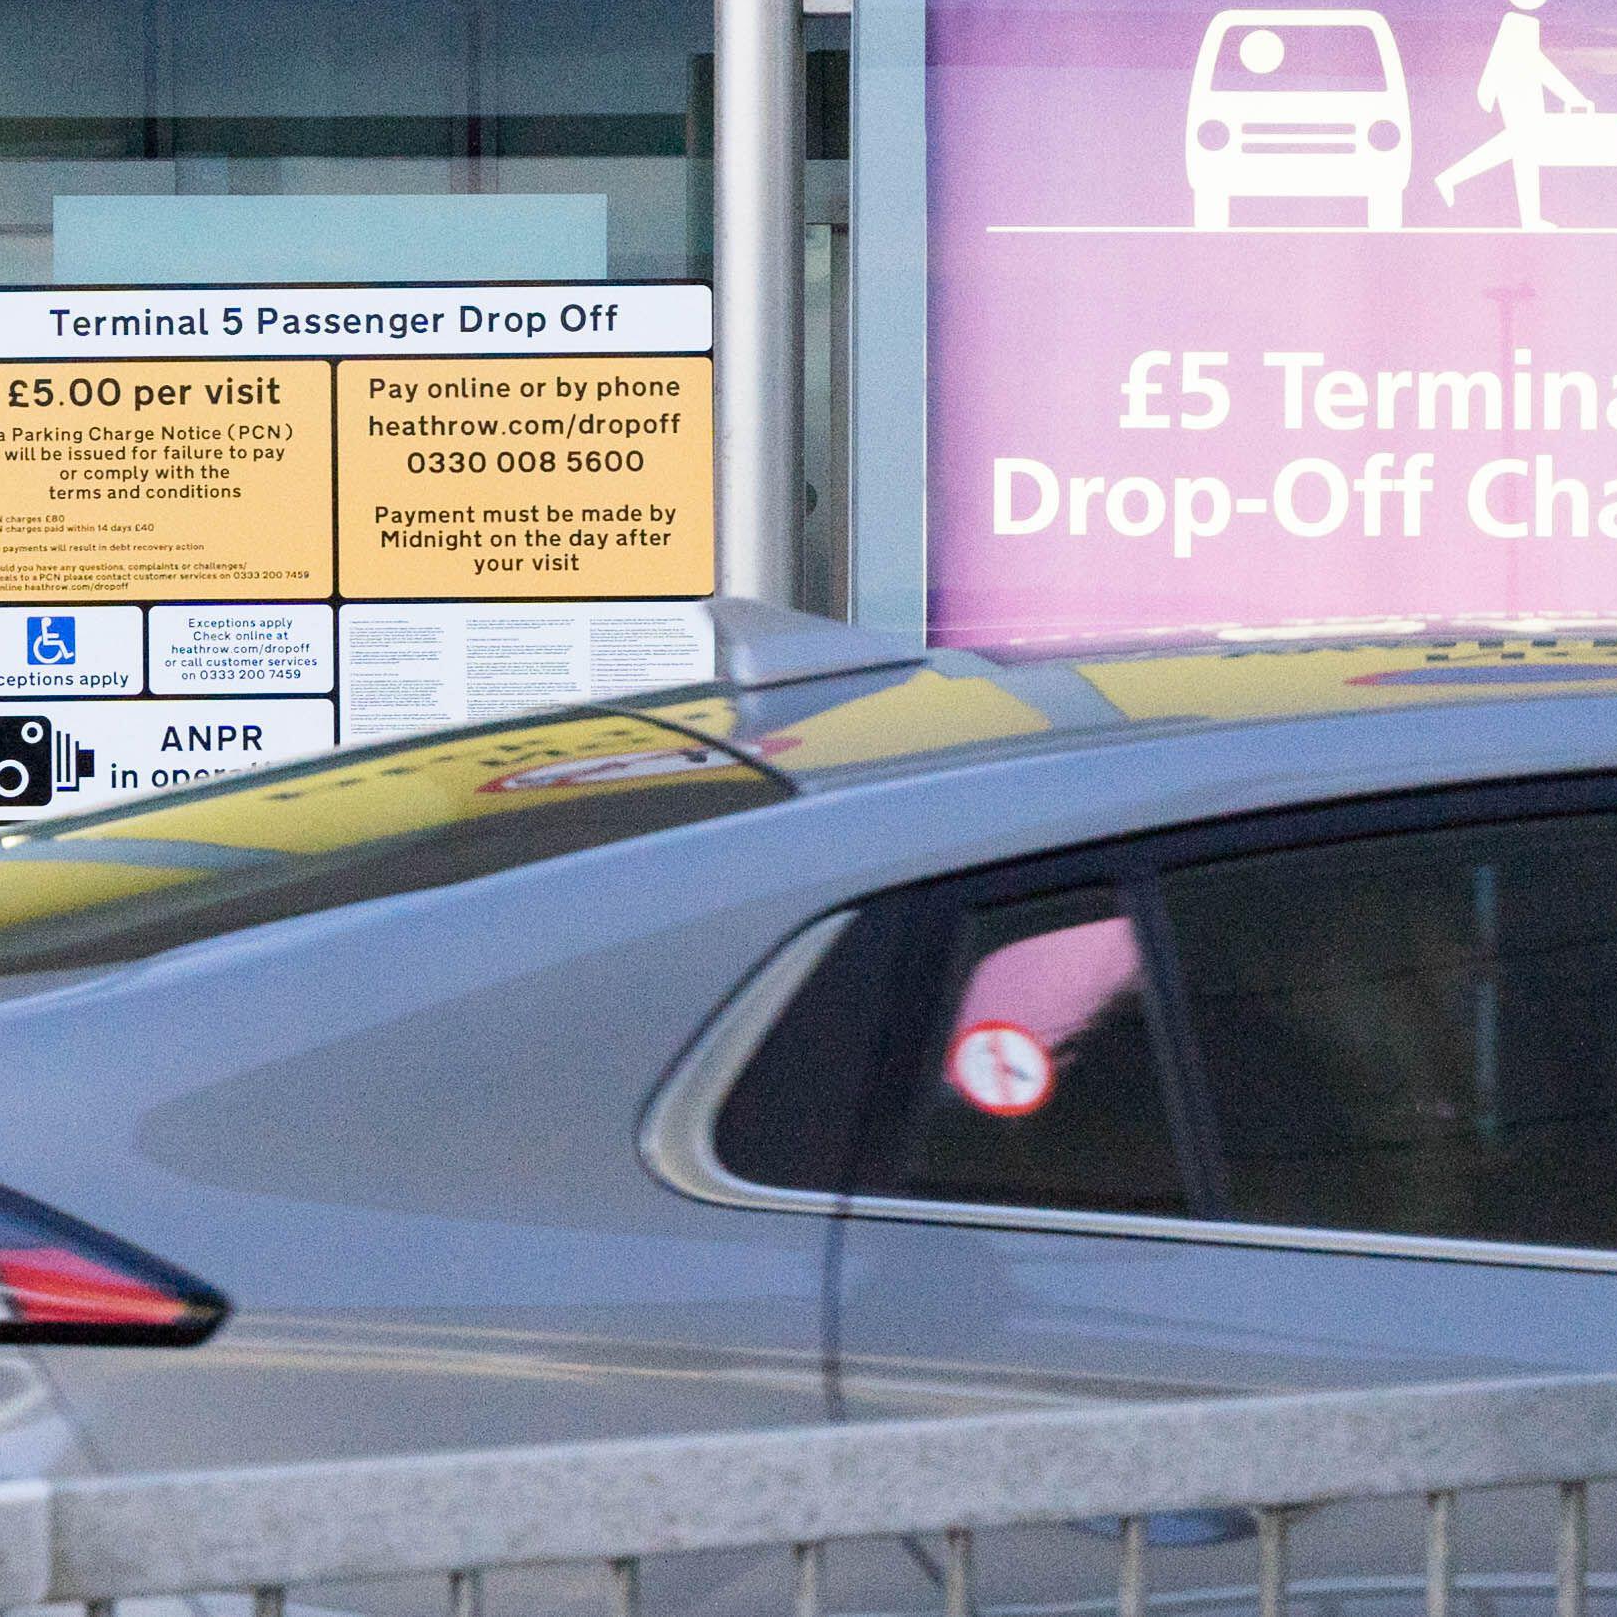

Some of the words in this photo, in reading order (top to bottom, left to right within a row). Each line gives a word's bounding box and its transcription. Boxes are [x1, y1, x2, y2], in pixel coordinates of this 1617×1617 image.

[49, 307, 208, 336] Terminal
[223, 307, 242, 335] 5
[258, 306, 444, 340] Passenger
[460, 305, 545, 338] Drop
[560, 303, 617, 332] Off
[8, 377, 120, 407] £5.00
[135, 384, 191, 411] per
[205, 377, 279, 404] visit
[369, 377, 417, 403] Pay
[427, 377, 510, 398] online
[520, 382, 546, 397] or
[557, 376, 587, 401] by
[597, 375, 679, 401] phone
[1119, 350, 1229, 429] £5
[12, 427, 82, 444] Parking
[89, 426, 153, 443] Charge
[161, 425, 221, 440] Notice
[227, 423, 292, 441] (PCN)
[369, 412, 680, 440] heathrow.com/dropoff
[5, 447, 35, 460] will
[41, 446, 61, 460] be
[68, 446, 125, 460] issued
[131, 445, 157, 460] for
[163, 445, 222, 459] failure
[229, 445, 247, 459] to
[253, 448, 284, 461] pay
[407, 451, 485, 473] 0330
[497, 451, 555, 472] 008
[567, 450, 643, 472] 5600
[59, 469, 77, 480] or
[83, 465, 148, 482] comply
[155, 465, 193, 479] with
[200, 464, 229, 478] the
[49, 485, 101, 499] terms
[107, 484, 139, 499] and
[145, 484, 241, 498] conditions
[375, 505, 474, 527] Payment
[483, 505, 539, 522] must
[547, 504, 573, 522] be
[582, 504, 641, 522] made
[650, 503, 675, 525] by
[994, 452, 1434, 557] Drop-Off
[5, 515, 41, 524] charges
[45, 514, 65, 523] £80
[381, 529, 481, 551] Midnight
[490, 534, 515, 547] on
[524, 529, 561, 546] the
[569, 529, 608, 549] day
[616, 528, 671, 545] after
[474, 558, 523, 575] your
[532, 553, 579, 571] visit
[188, 617, 255, 629] Exceptions
[259, 617, 292, 629] apply
[193, 631, 230, 641] Check
[235, 630, 272, 640] online
[276, 631, 288, 640] at
[171, 643, 309, 655] heathrow.com/dropoff
[165, 659, 176, 667] or
[181, 657, 202, 667] call
[206, 657, 263, 666] customer
[267, 656, 317, 666] services
[79, 671, 128, 688] apply
[199, 670, 234, 679] 0333
[239, 669, 265, 679] 200
[269, 669, 301, 679] 7459
[161, 725, 261, 751] ANPR
[111, 763, 138, 788] in
